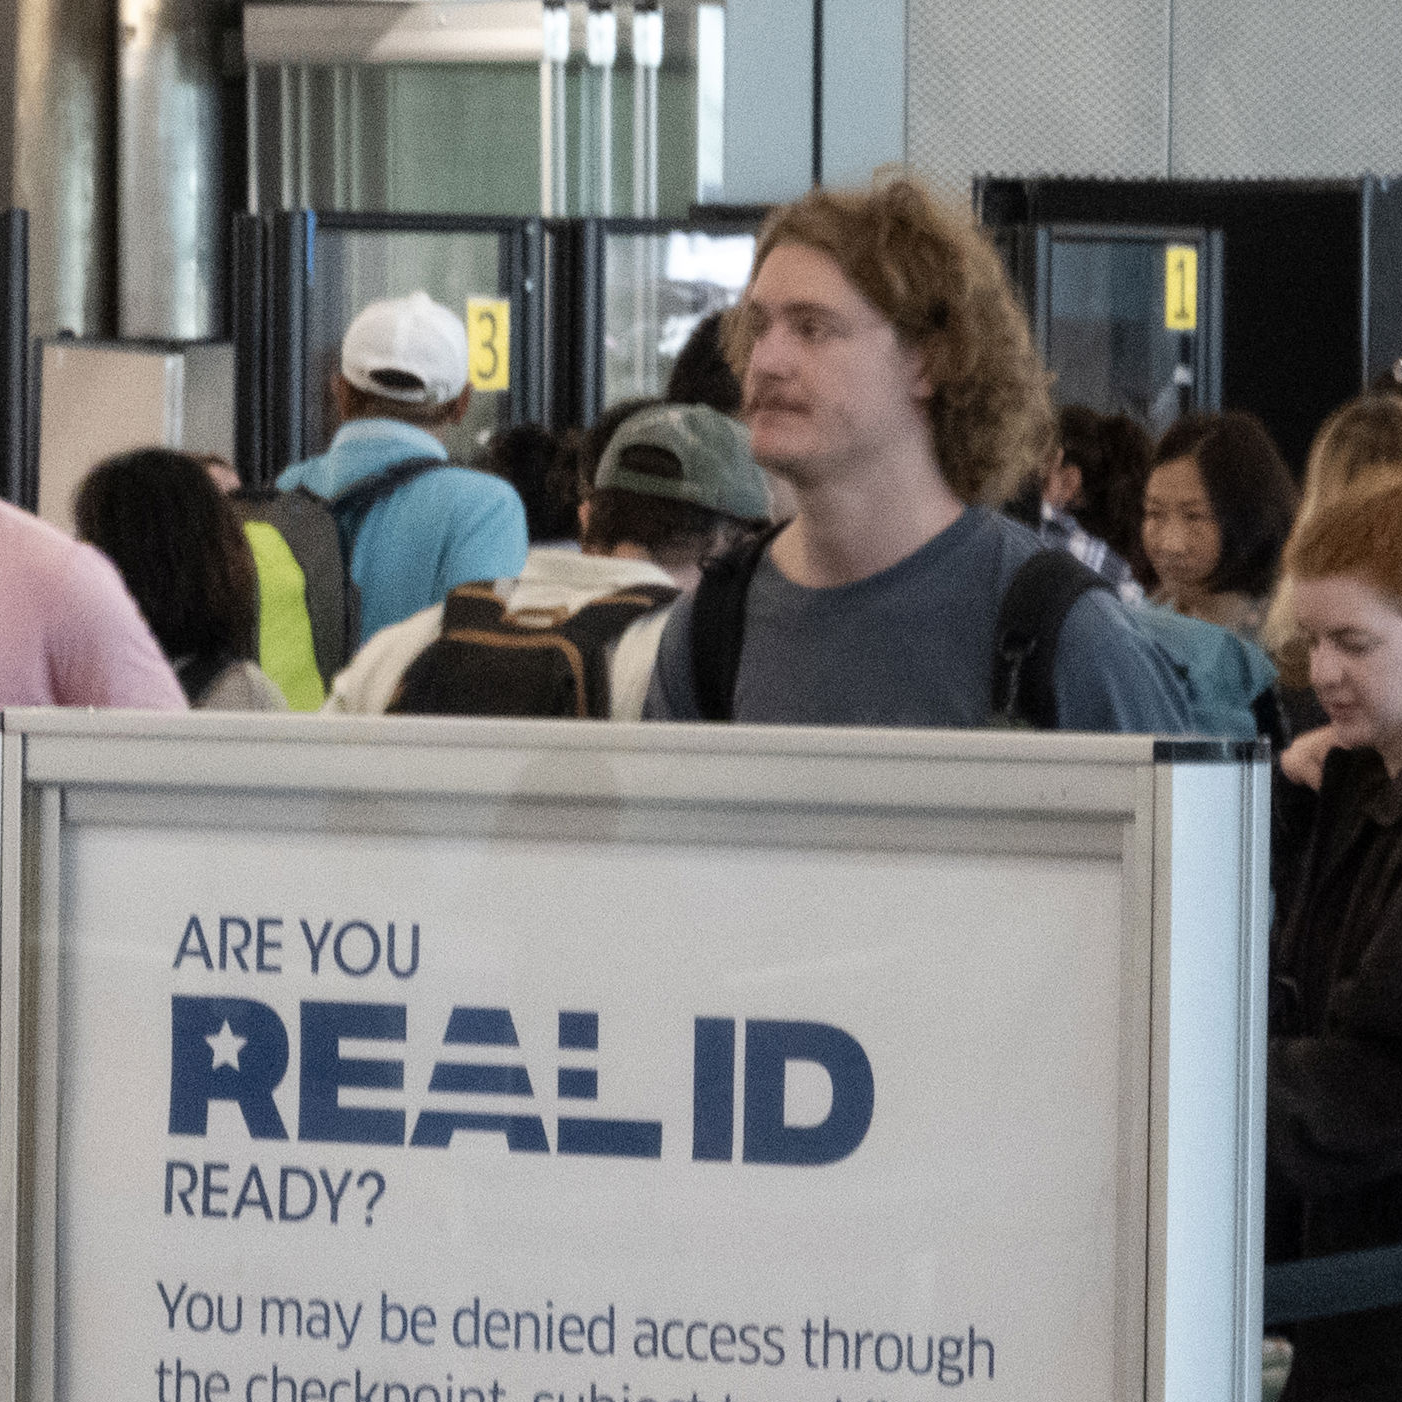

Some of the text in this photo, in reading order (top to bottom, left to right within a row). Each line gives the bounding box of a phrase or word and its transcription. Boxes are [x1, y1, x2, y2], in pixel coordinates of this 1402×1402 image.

[1173, 258, 1191, 320] 1
[476, 310, 499, 381] 3
[173, 914, 420, 979] ARE YOU
[168, 994, 875, 1167] REAL ID
[164, 1160, 386, 1226] READY?
[156, 1281, 995, 1388] You may be denied access through
